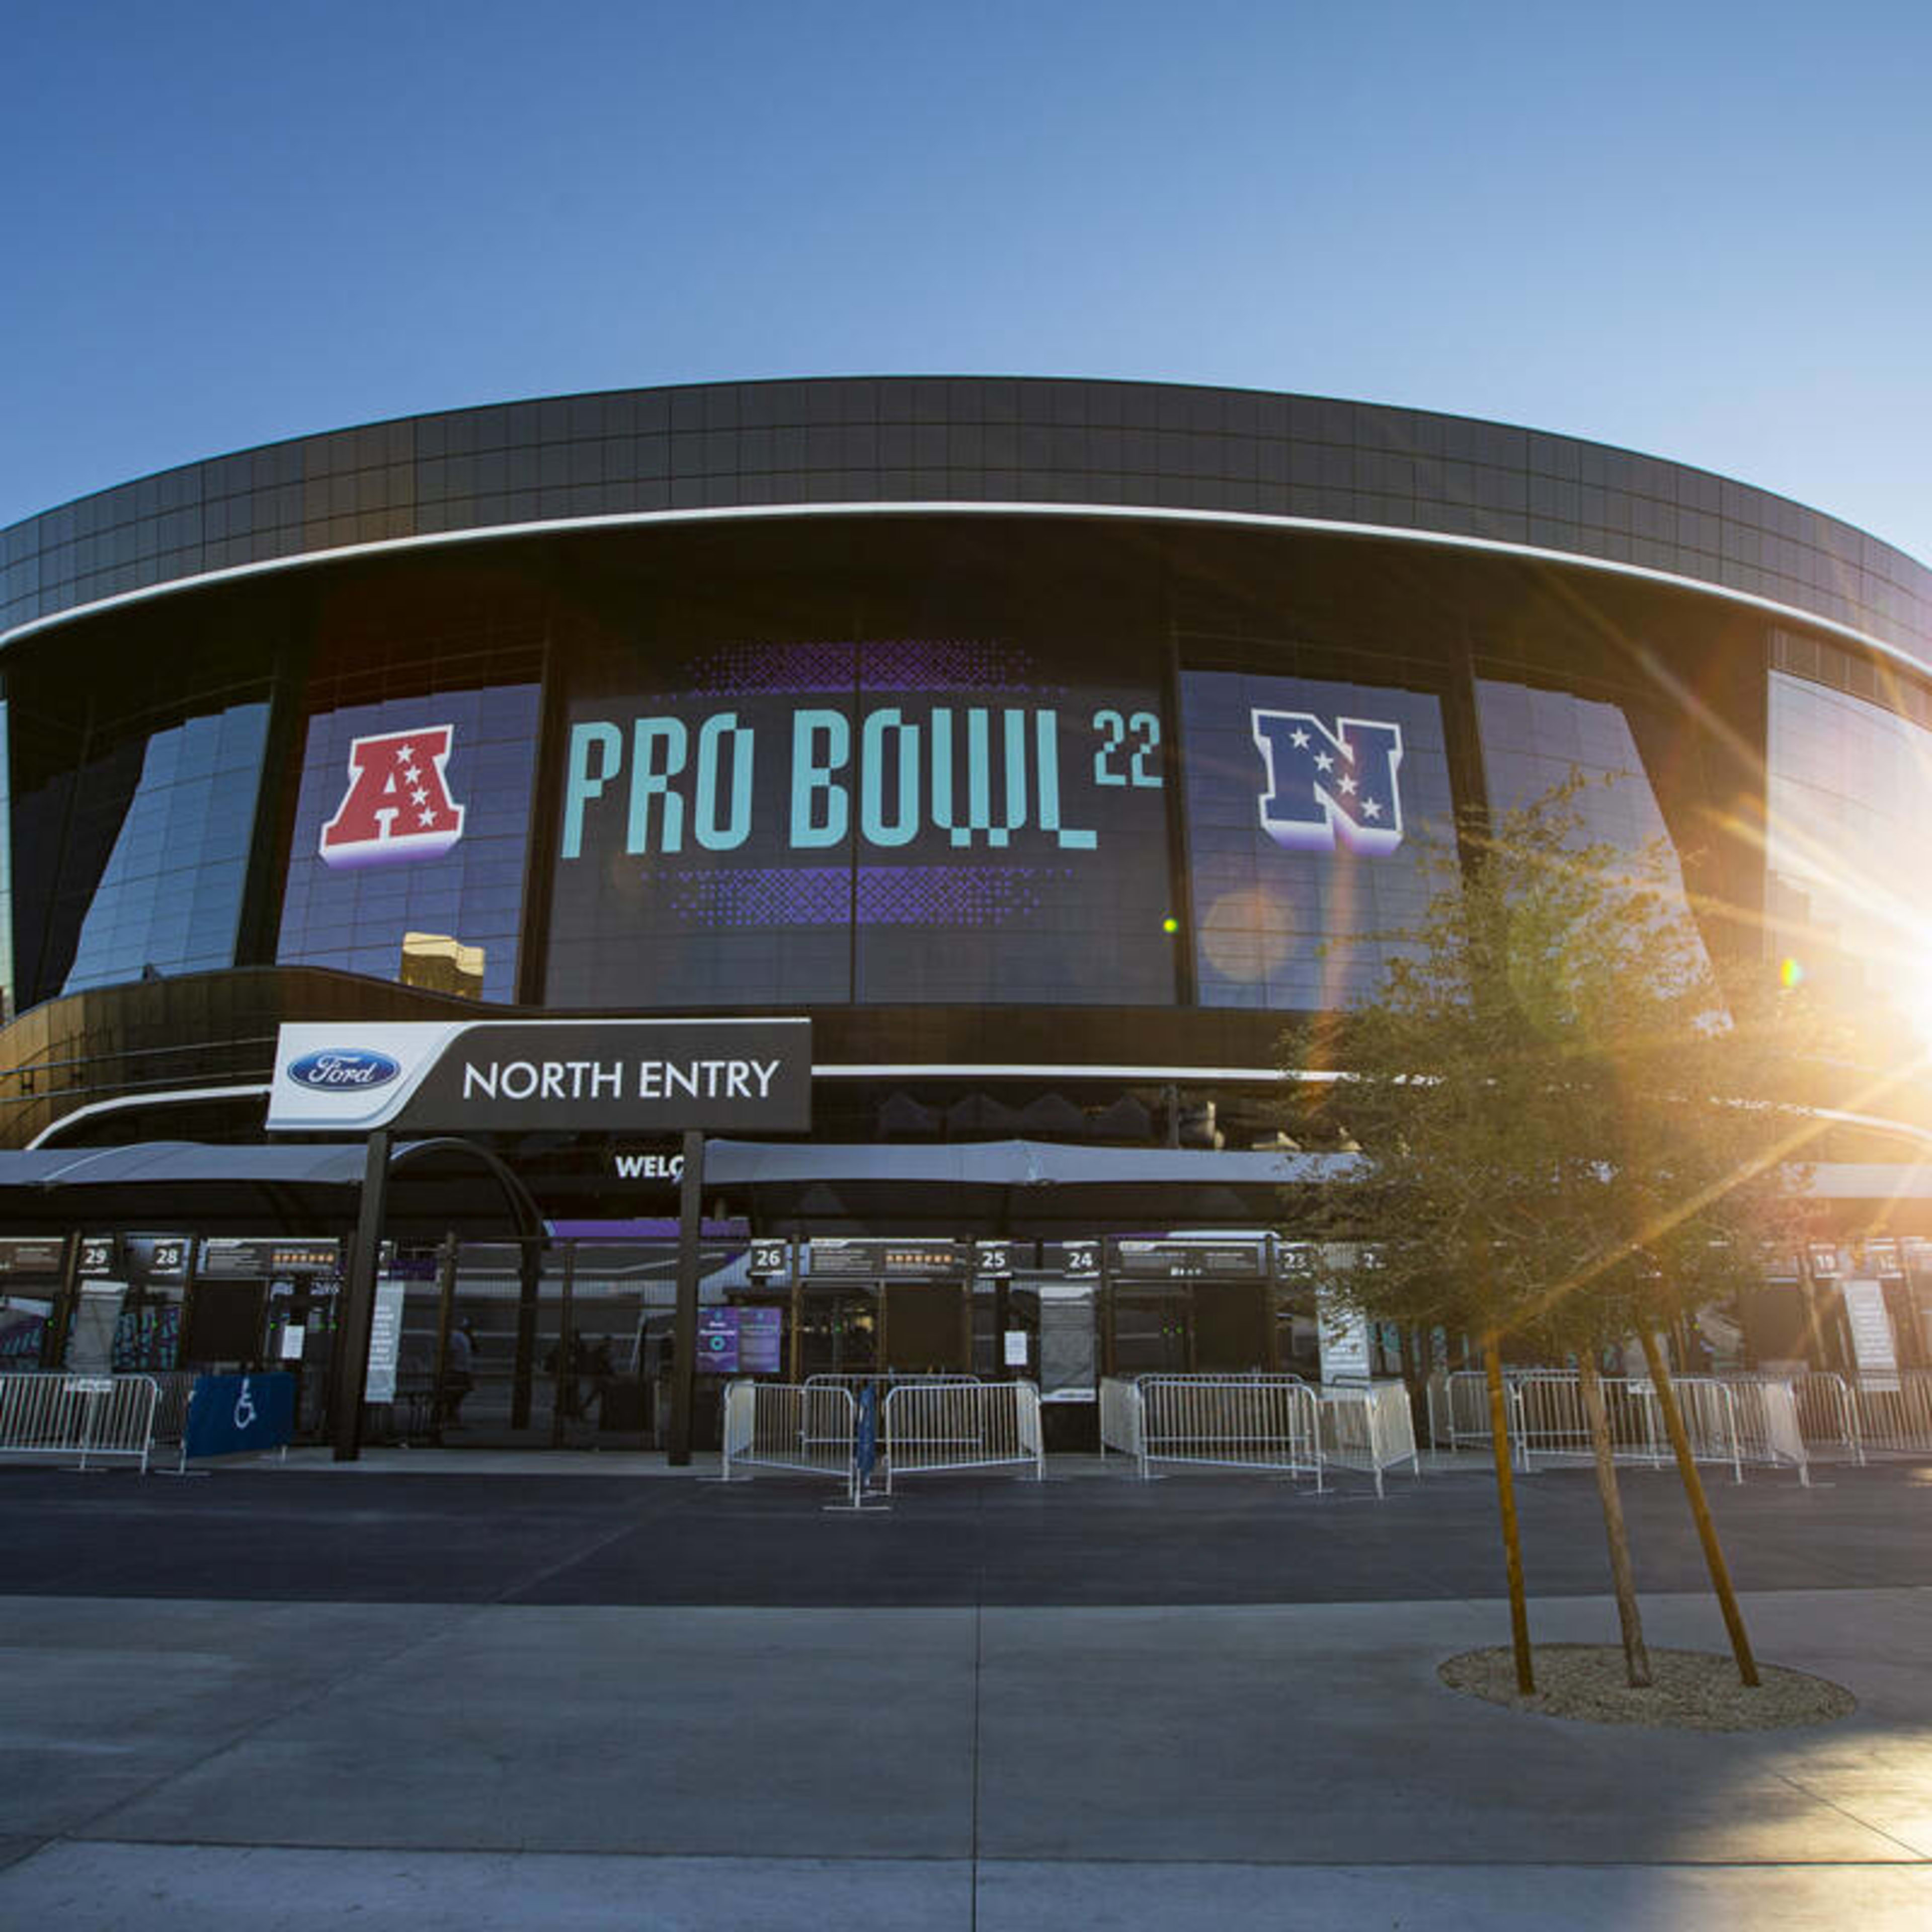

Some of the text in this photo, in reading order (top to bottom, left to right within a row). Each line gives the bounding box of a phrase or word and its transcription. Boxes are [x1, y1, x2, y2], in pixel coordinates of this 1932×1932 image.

[561, 707, 1163, 858] PRO BOWL 22
[1251, 708, 1404, 856] N
[319, 724, 465, 869] A
[308, 1055, 377, 1083] Ford
[463, 1060, 780, 1100] NORTH ENTRY
[84, 1249, 107, 1264] 29
[155, 1249, 178, 1264] 28
[757, 1250, 781, 1267] 26
[982, 1251, 1006, 1267] 25
[1069, 1252, 1093, 1268] 24
